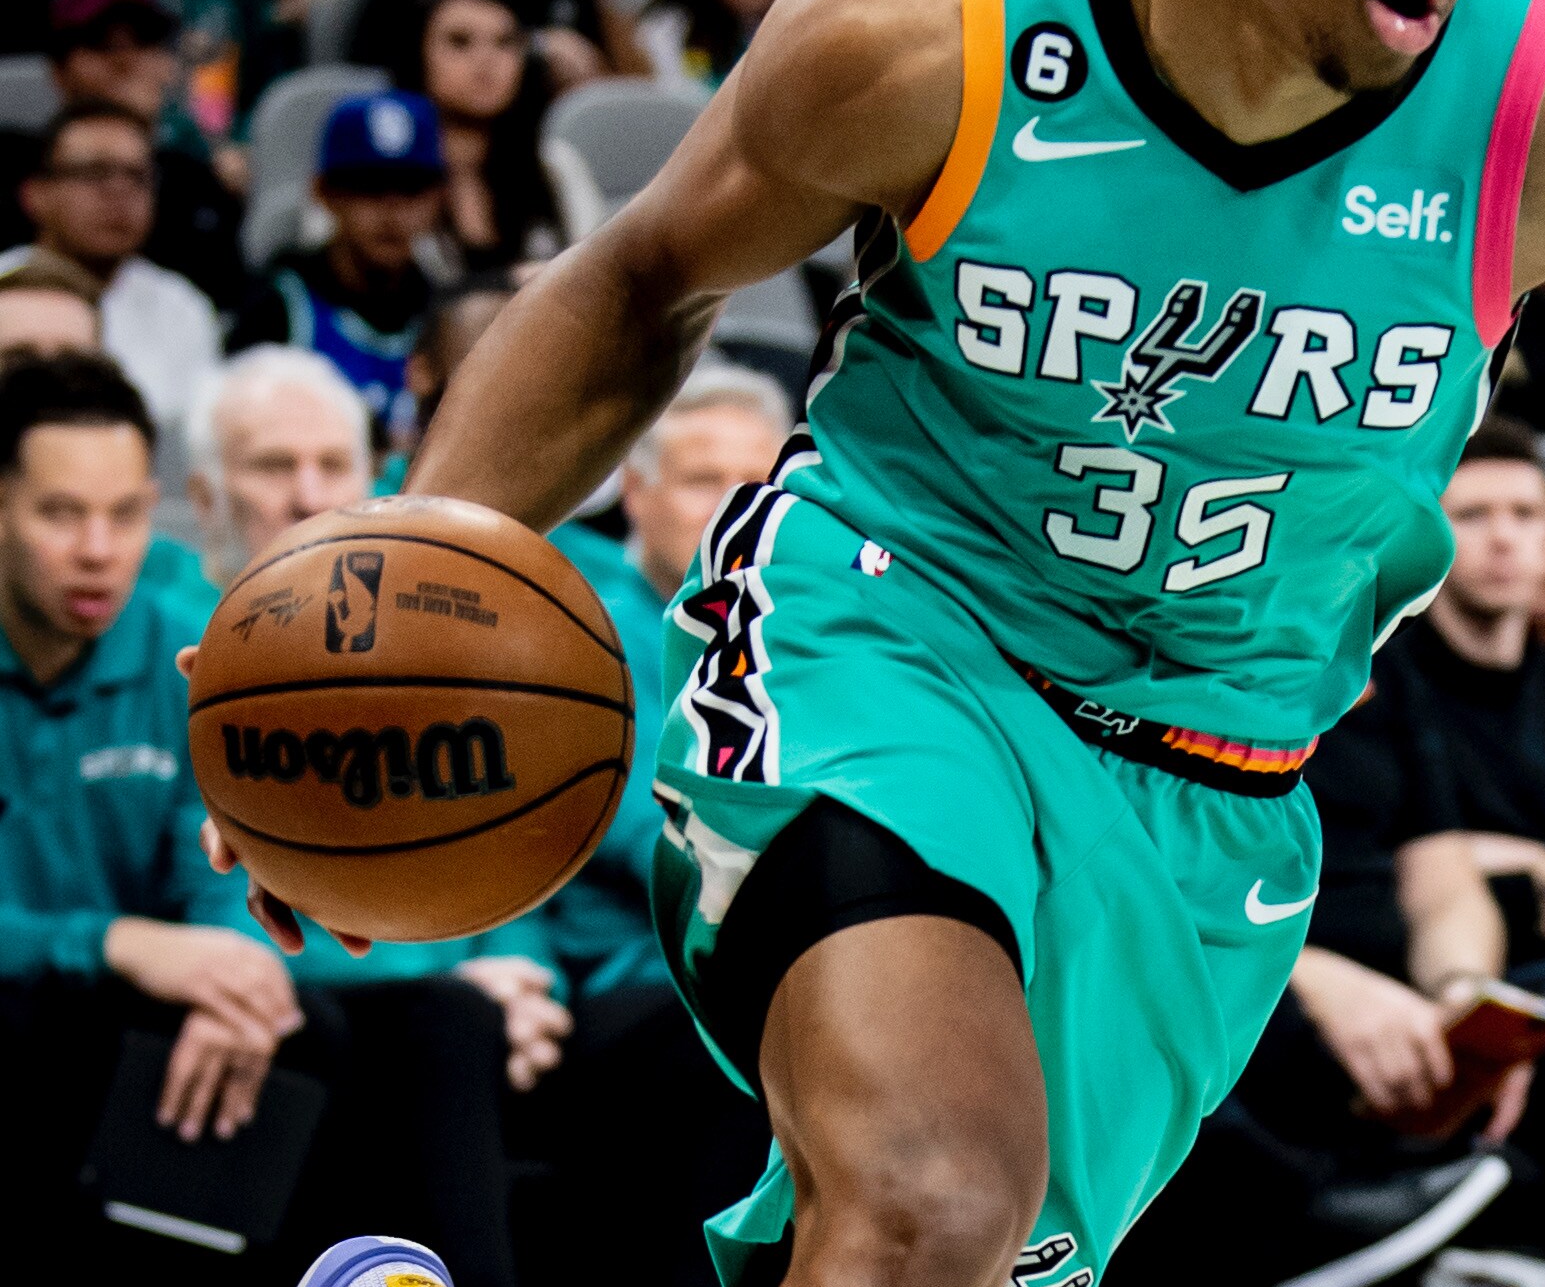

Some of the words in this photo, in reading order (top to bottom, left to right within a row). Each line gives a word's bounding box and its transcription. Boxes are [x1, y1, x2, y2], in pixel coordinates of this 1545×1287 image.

[1024, 31, 1073, 95] 6
[1341, 184, 1454, 244] Self.
[953, 261, 1455, 441] SPURS
[1043, 443, 1293, 594] 35
[221, 715, 517, 810] Wilson
